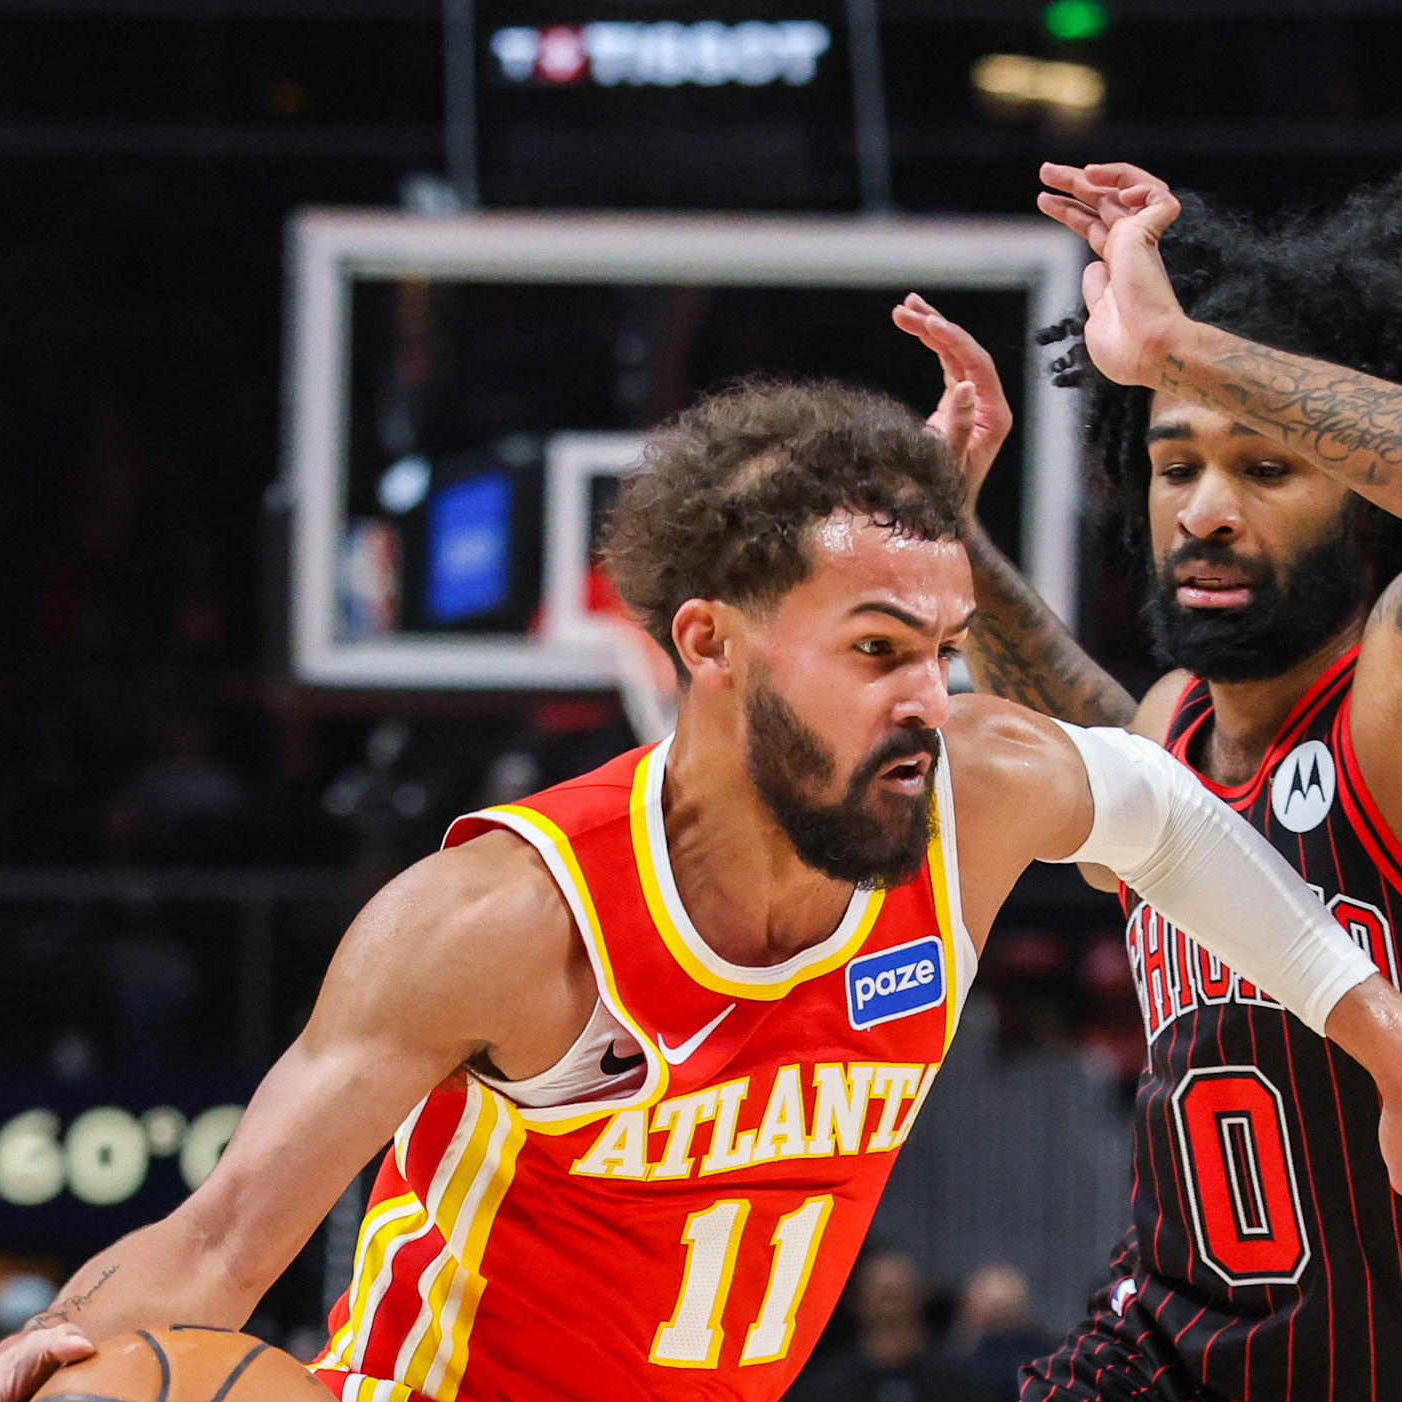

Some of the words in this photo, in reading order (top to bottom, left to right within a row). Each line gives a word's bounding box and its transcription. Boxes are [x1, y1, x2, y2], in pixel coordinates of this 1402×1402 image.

[855, 959, 935, 1011] paze
[1171, 1065, 1311, 1287] 0
[648, 1194, 834, 1369] 11
